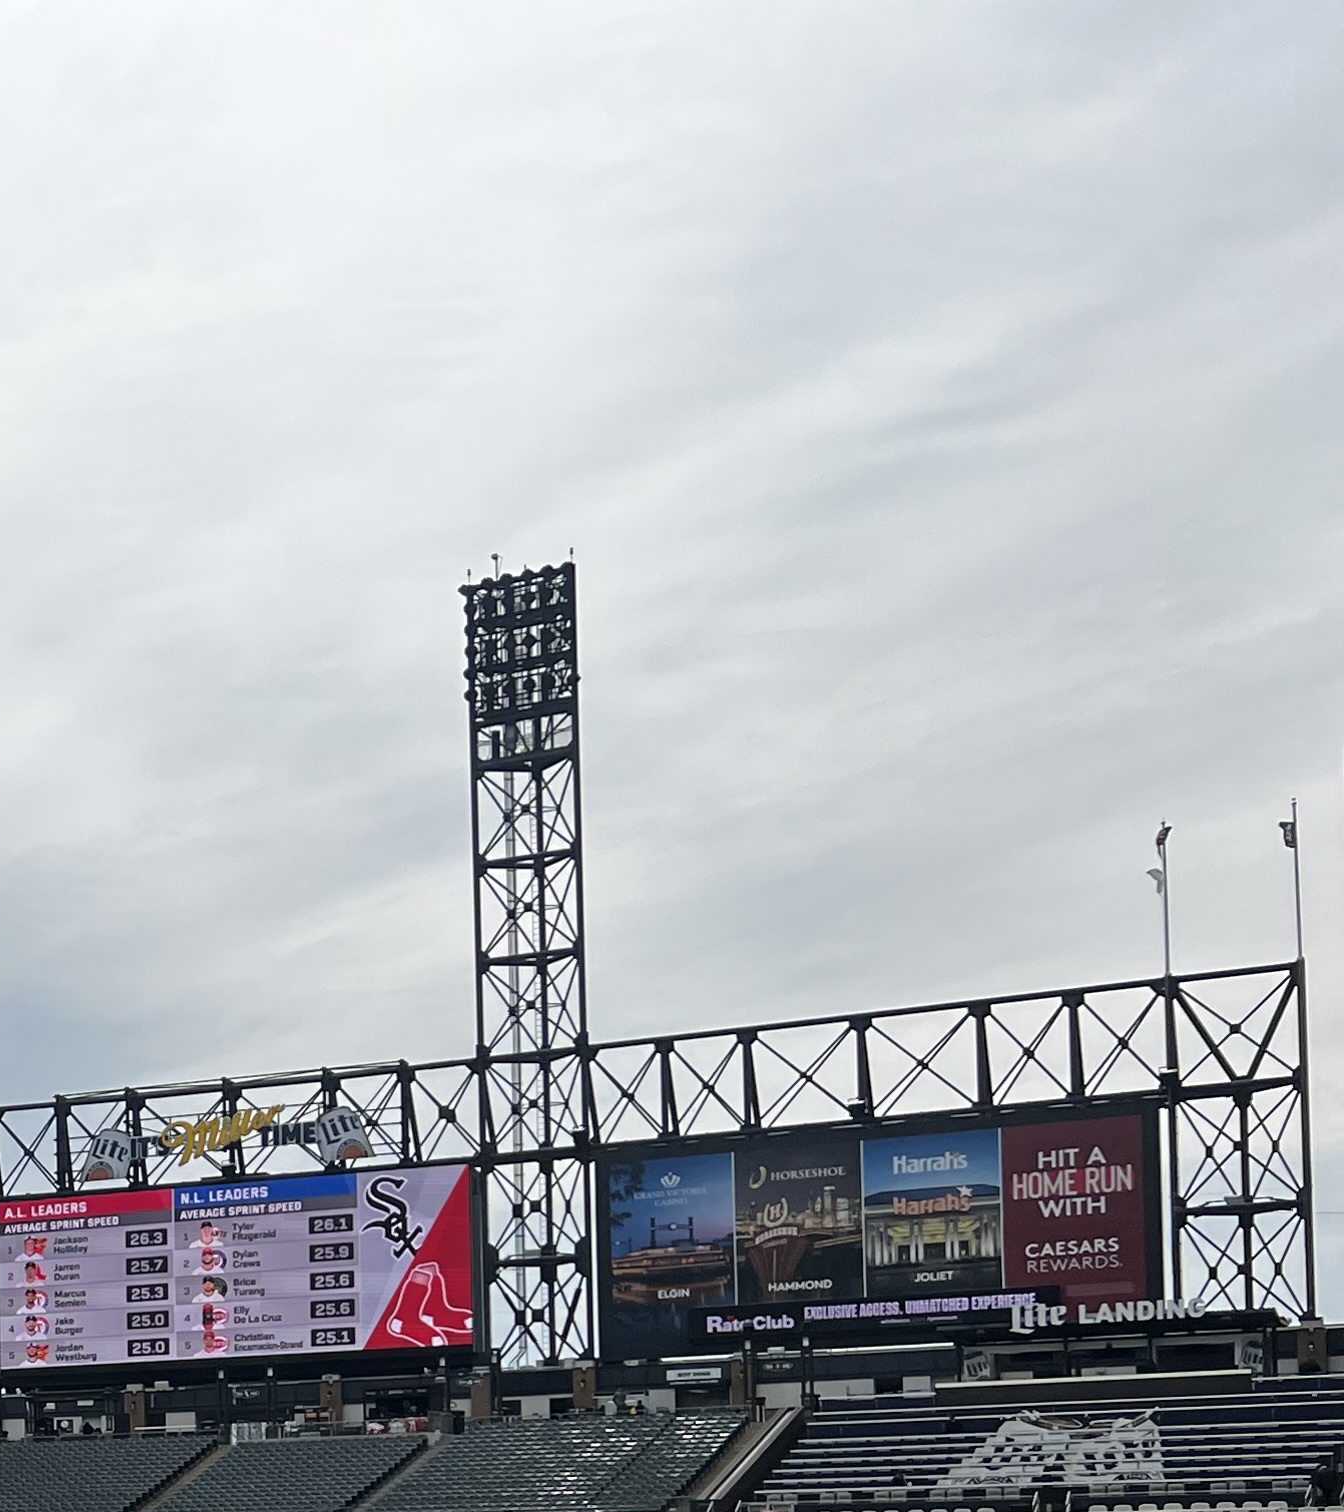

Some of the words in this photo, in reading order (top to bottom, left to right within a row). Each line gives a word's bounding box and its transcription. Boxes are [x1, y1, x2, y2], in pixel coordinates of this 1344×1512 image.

[162, 1103, 286, 1167] Miller
[262, 1123, 315, 1146] TIME
[321, 1111, 360, 1145] Lite
[91, 1137, 128, 1162] Lite
[893, 1152, 968, 1175] Harrah's
[1038, 1148, 1079, 1169] HIT
[1087, 1146, 1106, 1165] A
[770, 1166, 846, 1181] HORSESHOE
[1012, 1168, 1077, 1200] HOME
[1085, 1165, 1133, 1193] RUN
[180, 1193, 205, 1204] N.L.
[209, 1186, 268, 1201] LEADERS
[5, 1207, 27, 1219] A.L.
[31, 1202, 87, 1216] LEADERS
[180, 1207, 226, 1220] AVERAGE
[229, 1205, 264, 1216] SPRINT
[269, 1202, 302, 1212] SPEED
[1038, 1196, 1106, 1217] WITH
[4, 1222, 47, 1234] AVERAGE
[50, 1219, 84, 1230] SPRINT
[88, 1216, 119, 1227] SPEED
[314, 1218, 348, 1231] 26.1
[130, 1232, 163, 1245] 26.3
[314, 1246, 348, 1260] 25.9
[1025, 1238, 1119, 1258] CAESARS
[131, 1259, 163, 1272] 25.7
[315, 1275, 349, 1288] 25.6
[914, 1271, 953, 1282] JOLIET
[768, 1279, 832, 1292] HAMMOND
[131, 1287, 163, 1300] 25.3
[658, 1289, 690, 1299] ELGIN
[315, 1303, 350, 1316] 25.6
[804, 1304, 857, 1320] EXCLUSIVE
[1009, 1303, 1067, 1334] Lite
[1078, 1298, 1206, 1324] LANDING
[132, 1314, 164, 1327] 25.0
[753, 1315, 794, 1329] Club
[316, 1331, 350, 1344] 25.1
[132, 1341, 165, 1354] 25.0
